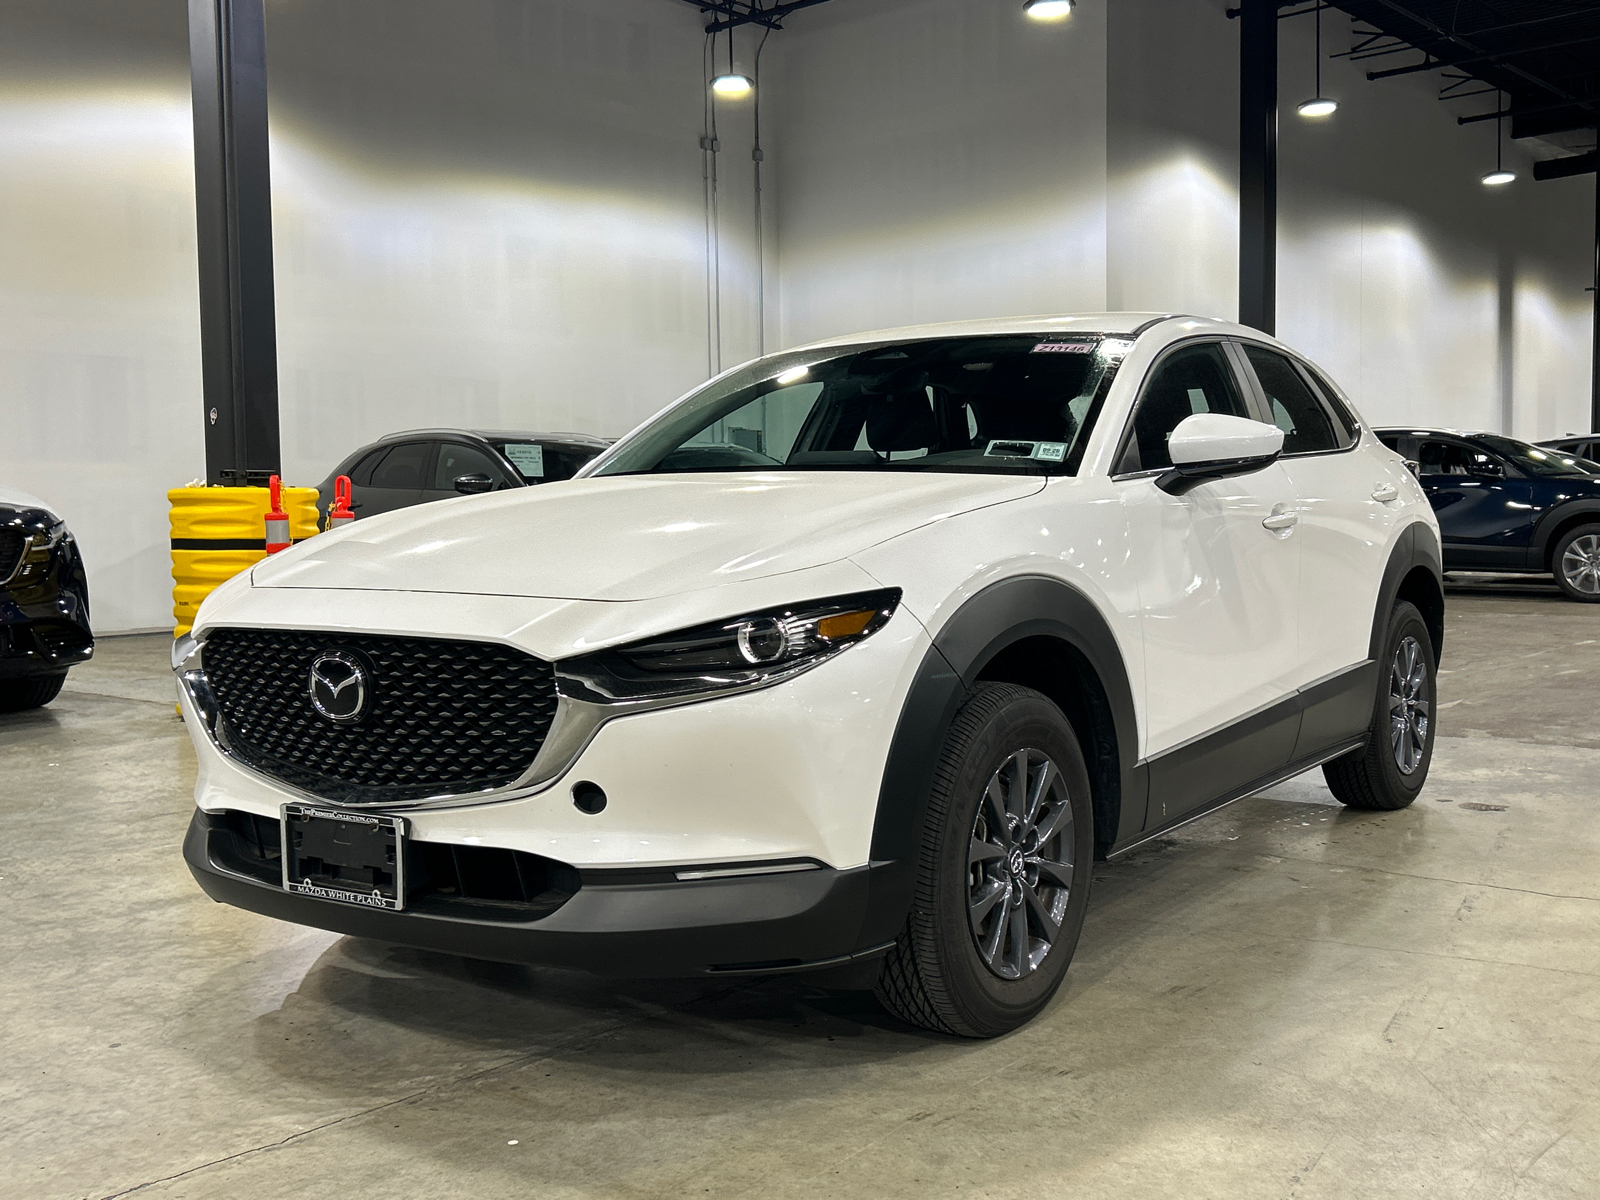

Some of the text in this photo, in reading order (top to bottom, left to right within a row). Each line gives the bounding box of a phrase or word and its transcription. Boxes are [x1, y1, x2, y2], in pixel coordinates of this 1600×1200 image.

[297, 886, 386, 907] MAZDA WHITE PLAINS
